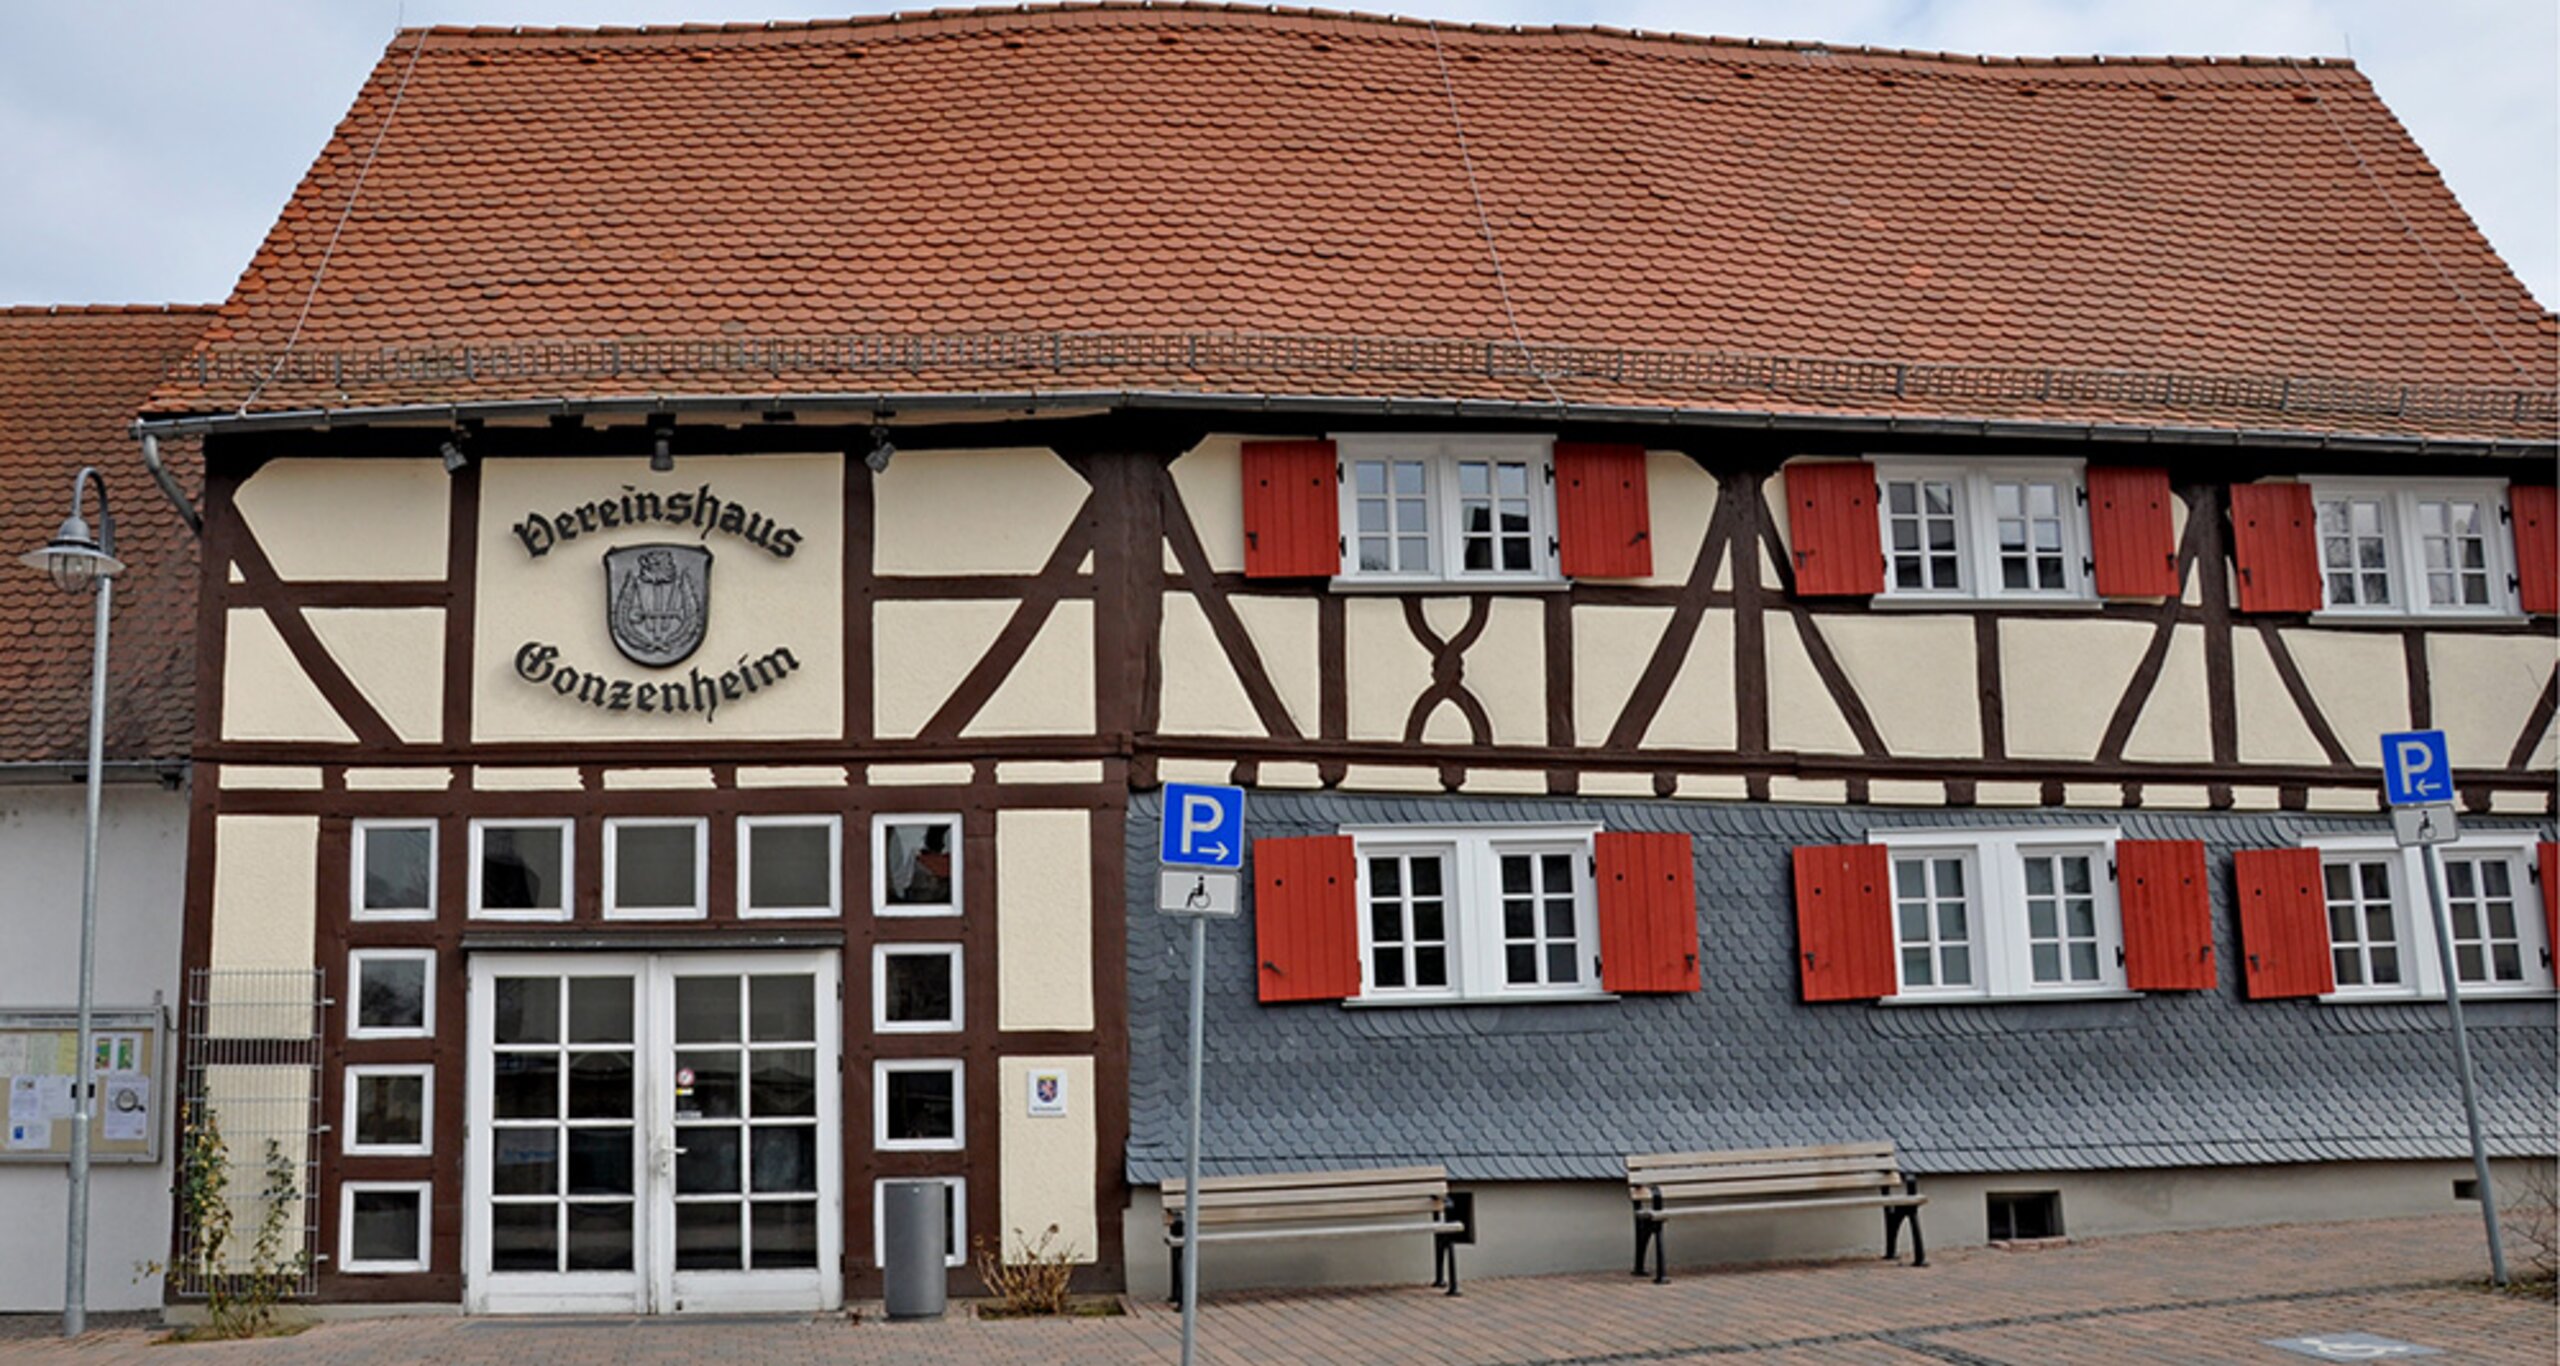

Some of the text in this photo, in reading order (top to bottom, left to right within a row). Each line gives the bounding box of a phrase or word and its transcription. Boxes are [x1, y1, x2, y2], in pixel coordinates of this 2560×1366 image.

[513, 484, 804, 558] Vereinshaus
[514, 641, 800, 723] Gonzenheim
[2397, 741, 2433, 794] P
[1180, 794, 1224, 854] P
